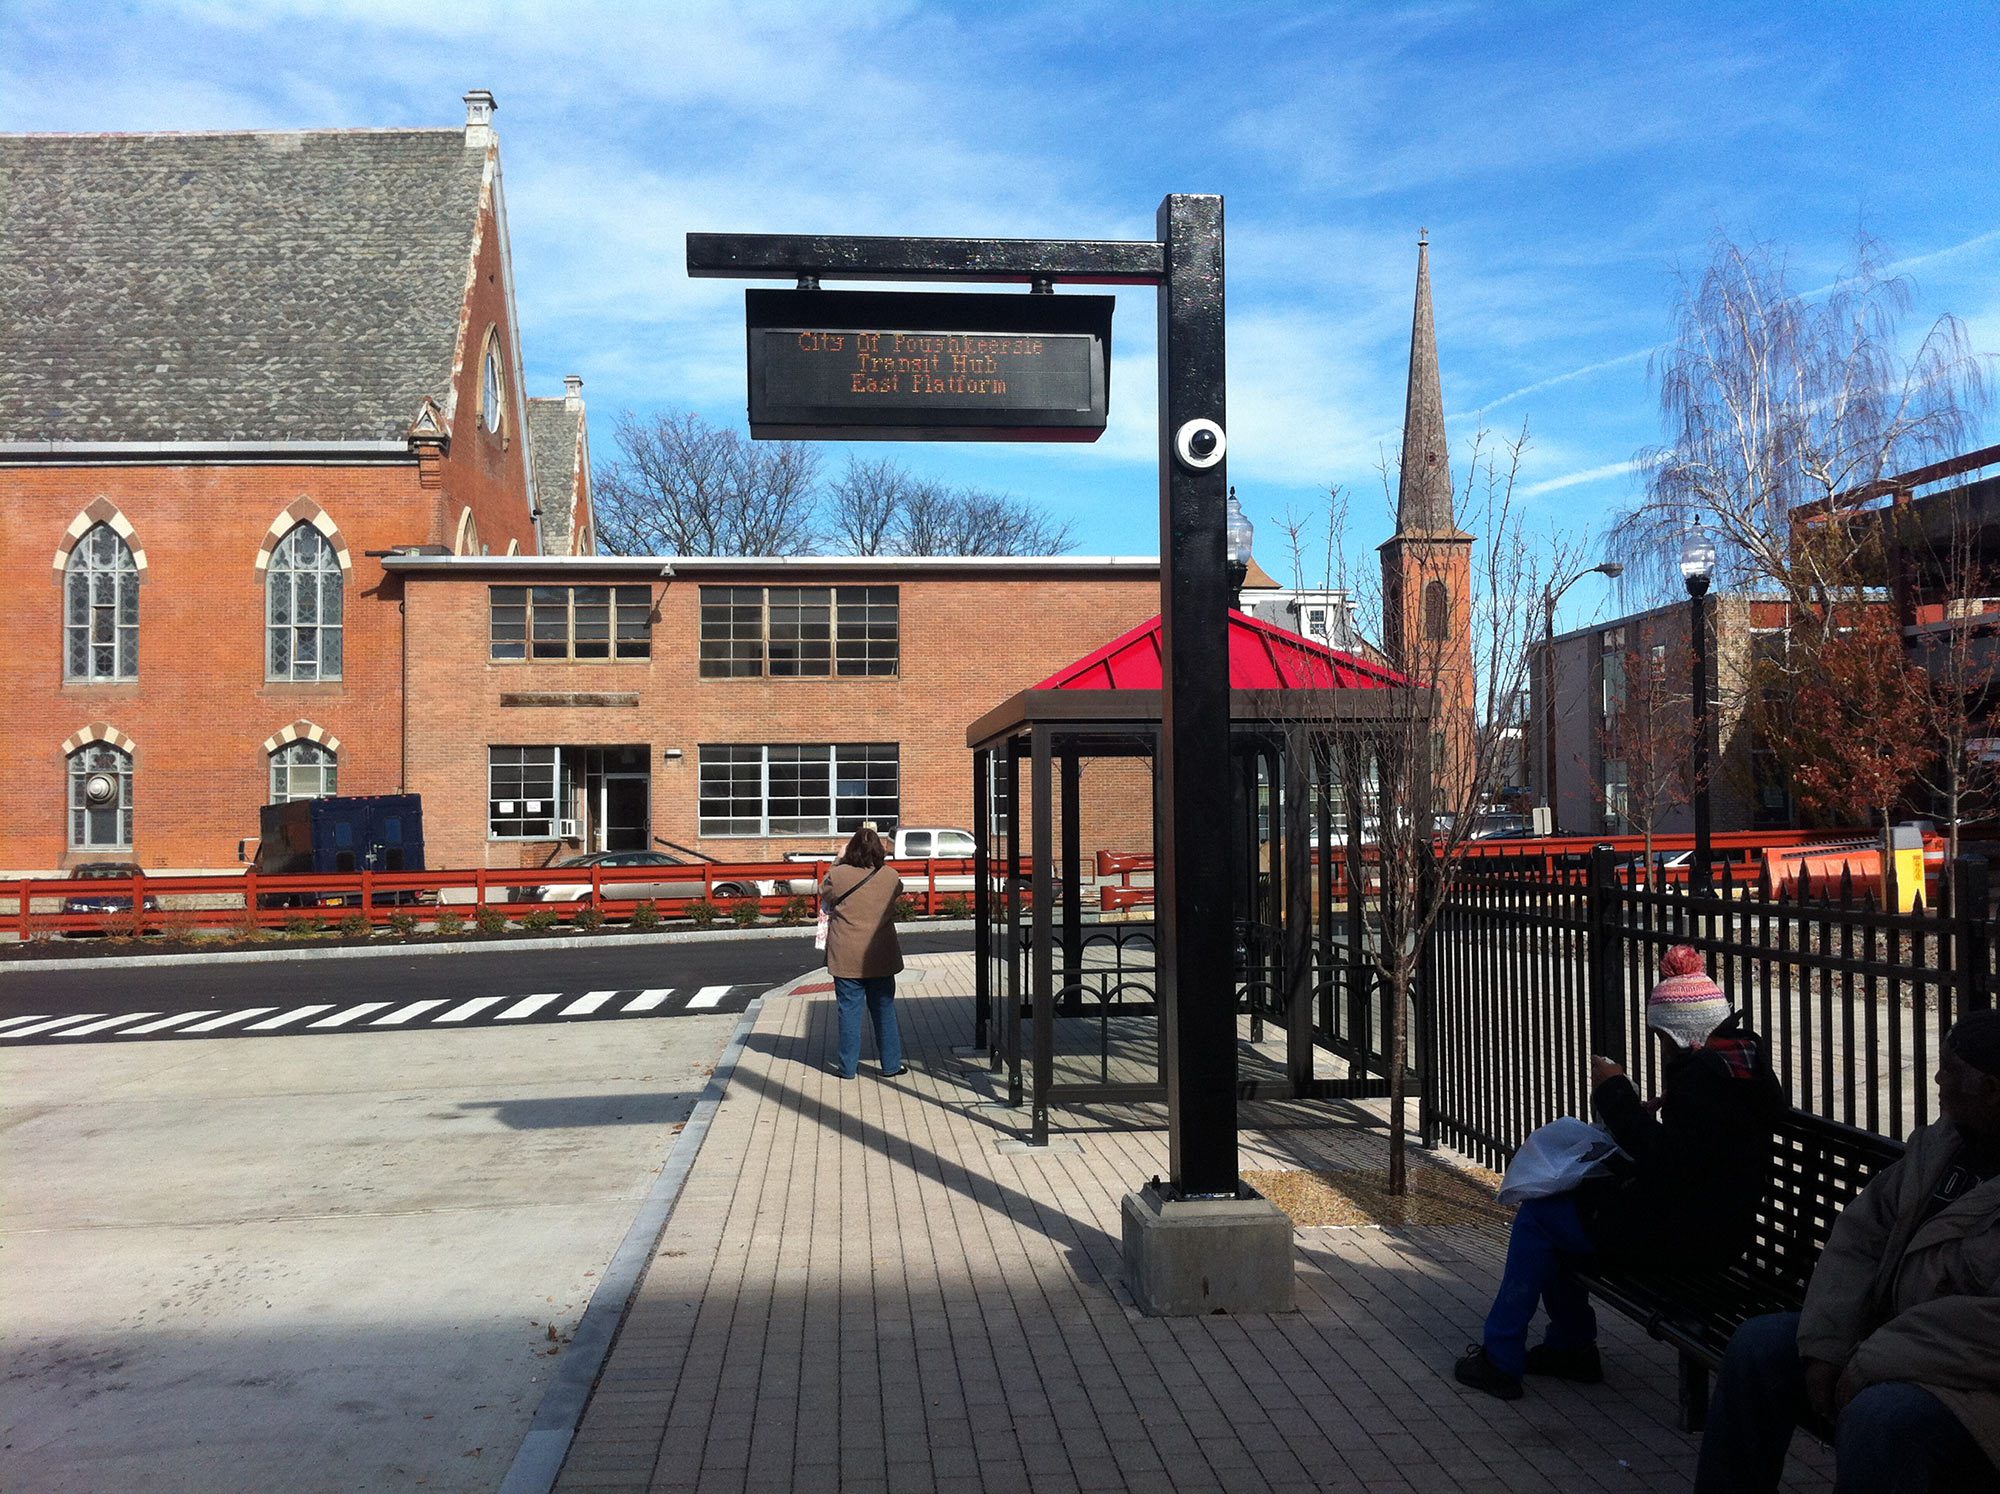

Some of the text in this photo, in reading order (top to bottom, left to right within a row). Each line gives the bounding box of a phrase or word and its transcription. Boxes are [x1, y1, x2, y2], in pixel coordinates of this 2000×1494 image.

[799, 331, 845, 352] City
[857, 332, 881, 352] Of
[858, 353, 997, 373] Transit Hub
[850, 373, 1008, 395] East Platform
